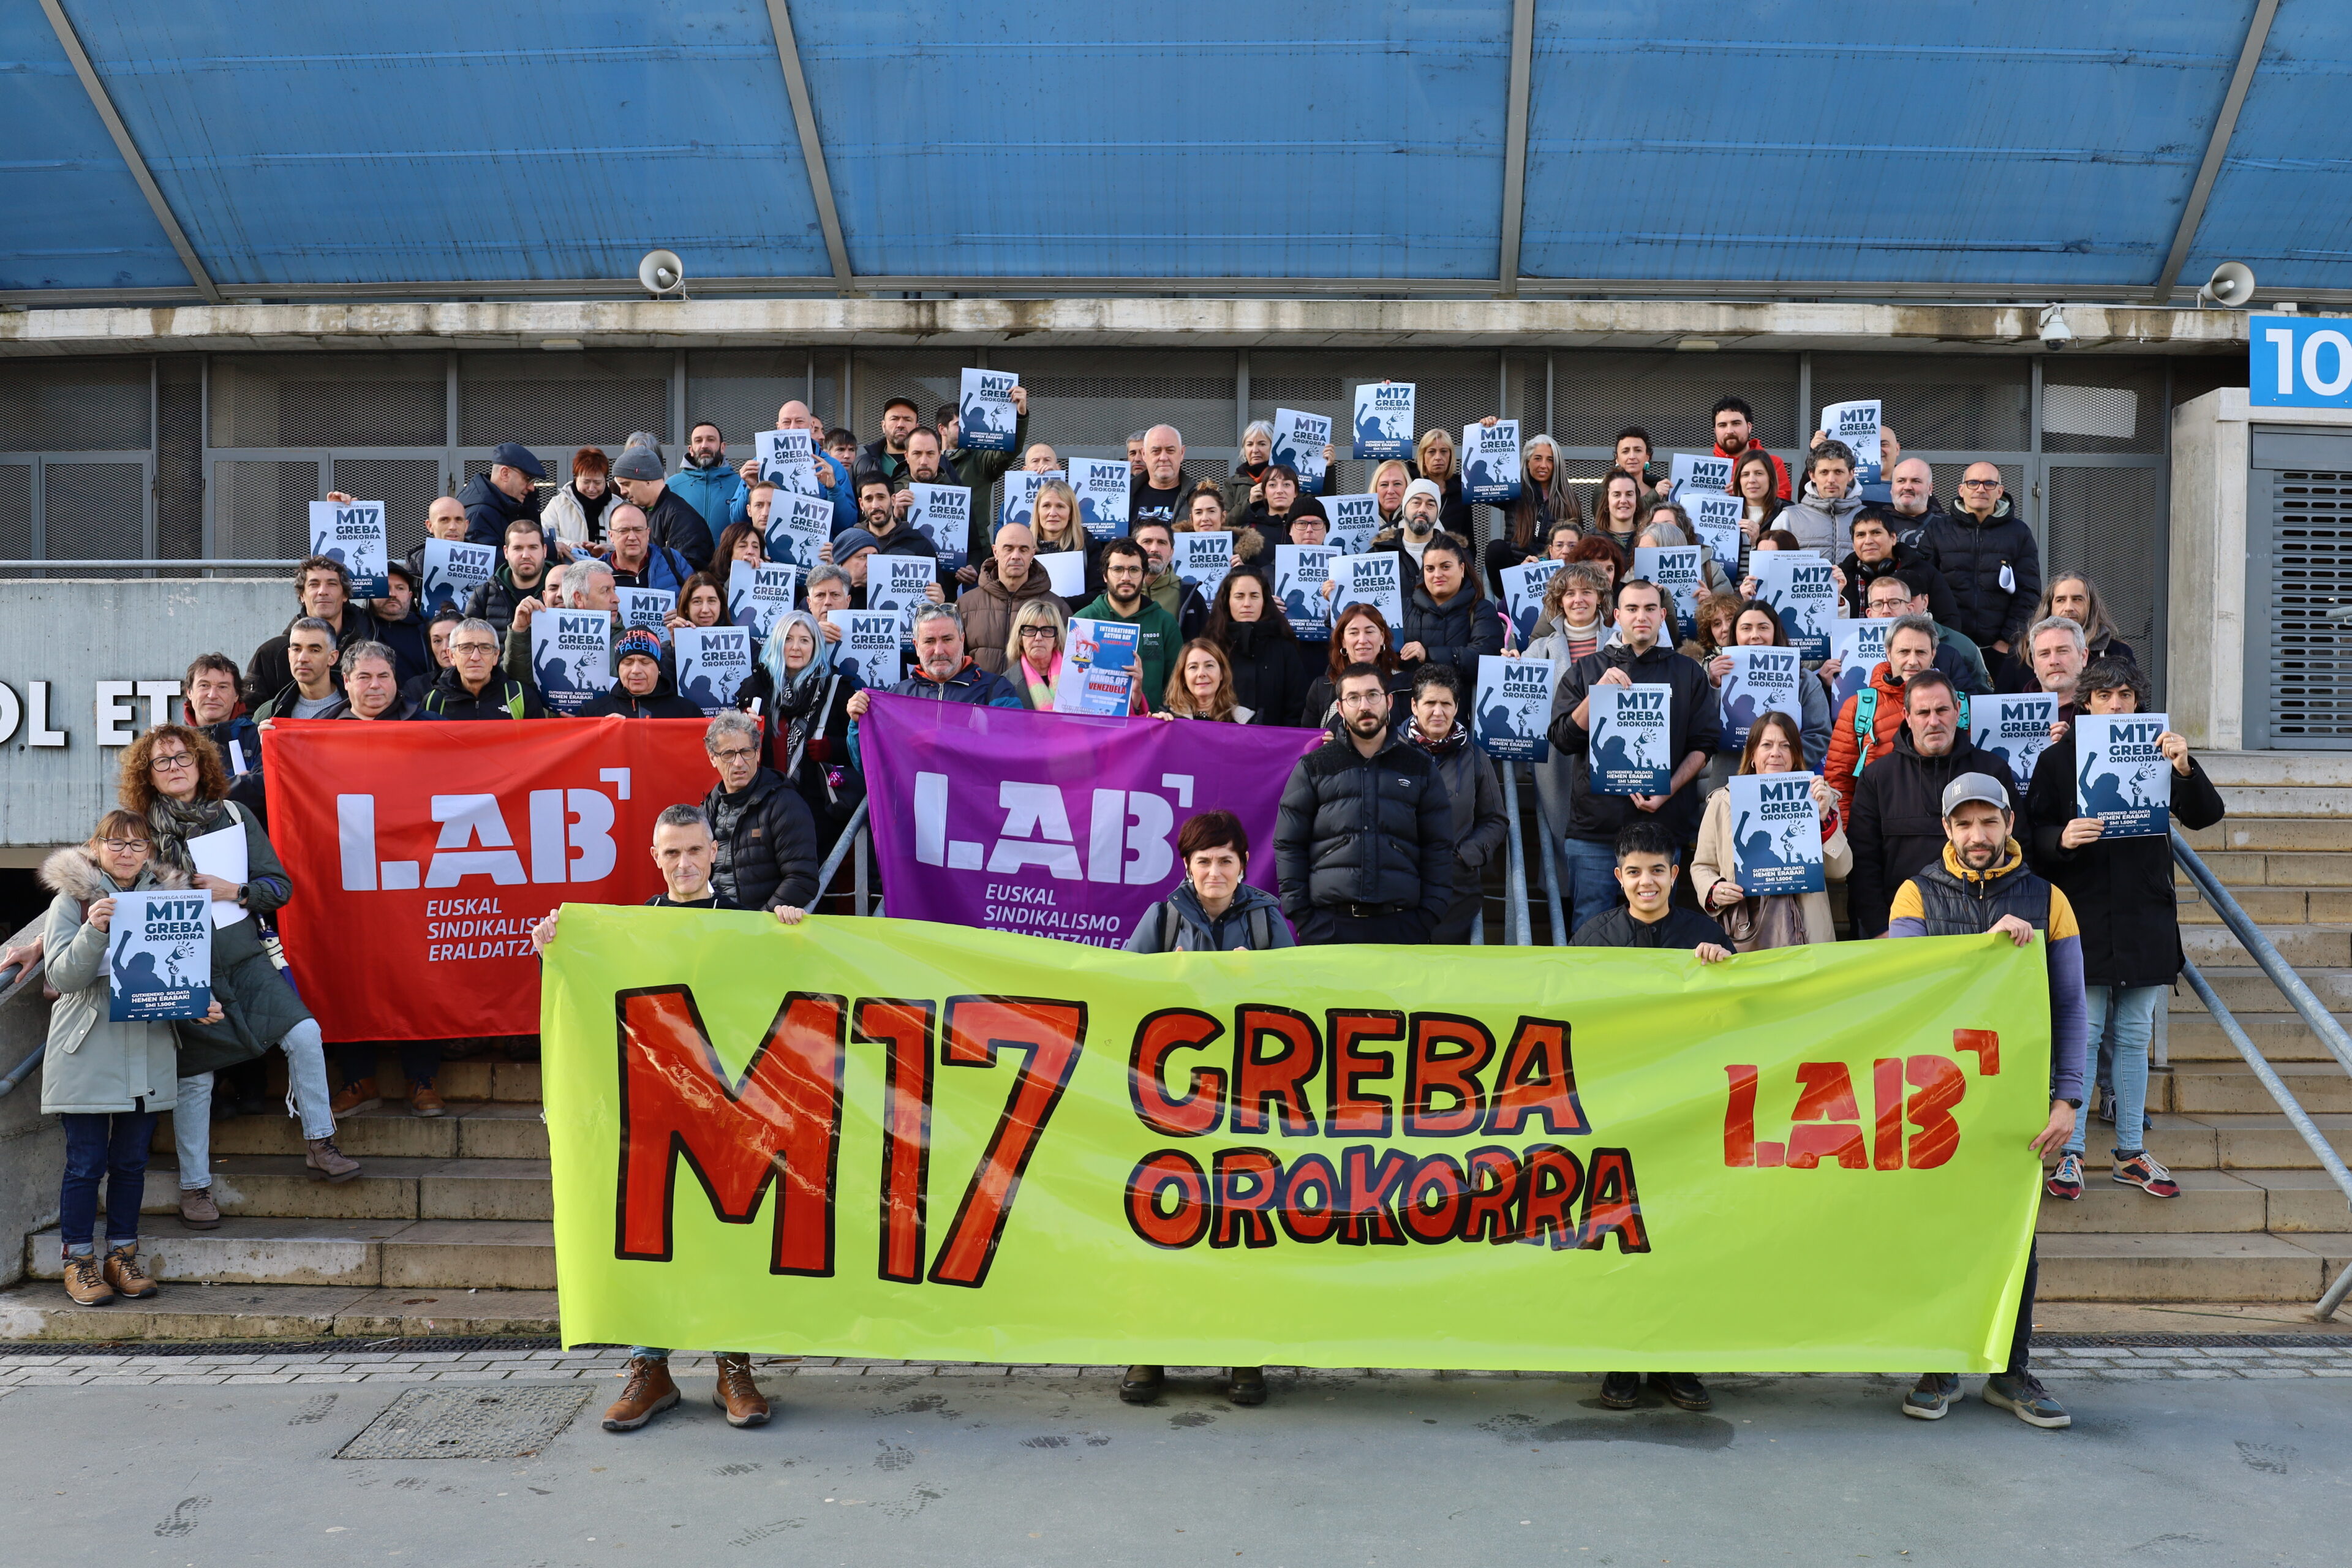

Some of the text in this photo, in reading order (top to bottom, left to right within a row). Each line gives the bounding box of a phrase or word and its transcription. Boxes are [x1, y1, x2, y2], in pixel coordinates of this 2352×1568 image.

[2266, 328, 2352, 396] 10
[981, 376, 1014, 390] M17
[1376, 388, 1411, 399] M17
[1840, 409, 1876, 423] M17
[1294, 418, 1328, 434] M17
[1480, 426, 1514, 440] M17
[773, 435, 808, 450] M17
[1292, 438, 1325, 447] OROKORRA
[1294, 431, 1326, 442] GREBA
[774, 450, 810, 459] GREBA
[1090, 465, 1126, 479] M17
[1693, 462, 1728, 477] M17
[1692, 476, 1726, 486] GREBA
[930, 491, 966, 506] M17
[793, 501, 832, 521] M17
[929, 505, 965, 515] GREBA
[1338, 501, 1374, 516] M17
[1701, 500, 1738, 516] M17
[336, 508, 379, 524] M17
[791, 516, 828, 531] GREBA
[1338, 516, 1374, 525] GREBA
[1700, 515, 1736, 526] GREBA
[336, 526, 380, 534] GREBA
[790, 524, 827, 536] OROKORRA
[1189, 539, 1227, 554] M17
[449, 548, 491, 566] M17
[1189, 554, 1229, 563] GREBA
[1659, 554, 1698, 569] M17
[447, 571, 488, 581] OROKORRA
[448, 564, 488, 576] GREBA
[892, 563, 932, 578] M17
[1298, 568, 1329, 577] GREB
[1352, 560, 1393, 577] M17
[1658, 570, 1698, 579] GREBA
[1793, 567, 1834, 583] M17
[754, 570, 791, 586] M17
[1353, 576, 1395, 587] GREBA
[753, 586, 790, 597] GREBA
[1791, 584, 1833, 593] GREBA
[631, 595, 671, 612] M17
[630, 611, 663, 621] GREB
[559, 617, 605, 634] M17
[852, 618, 894, 633] M17
[1099, 626, 1136, 635] INTERNATIONAL
[559, 635, 605, 645] GREBA
[851, 635, 895, 644] GREBA
[1859, 626, 1888, 642] M1
[614, 635, 648, 653] NORTH
[619, 642, 648, 655] FACE
[701, 634, 744, 650] M17
[702, 651, 746, 661] GREBA
[1749, 654, 1795, 671] M17
[1090, 674, 1128, 685] HANDS OFF
[1504, 665, 1549, 683] M17
[1748, 671, 1794, 682] GREBA
[1088, 682, 1126, 694] VENEZUELA
[1503, 683, 1548, 693] GREBA
[1618, 693, 1664, 709] M17
[1617, 711, 1664, 720] GREBA
[2002, 702, 2052, 721] M17
[2001, 722, 2051, 732] GREBA
[2110, 723, 2163, 743] M17
[1760, 781, 1811, 802] M17
[1760, 801, 1813, 814] GREBA
[1761, 812, 1812, 821] OROKORRA
[914, 771, 1174, 885] LAB
[337, 788, 617, 891] LAB
[986, 883, 1057, 906] EUSKAL
[146, 900, 204, 922] M17
[426, 897, 503, 917] EUSKAL
[984, 905, 1120, 932] SINDIKALISMO
[145, 921, 204, 934] GREBA
[145, 933, 203, 941] OROKORRA
[1128, 1003, 1592, 1138] GREBA
[1724, 1054, 1967, 1171] LAB
[614, 984, 1088, 1288] M17
[1123, 1143, 1651, 1254] OROKORRA
